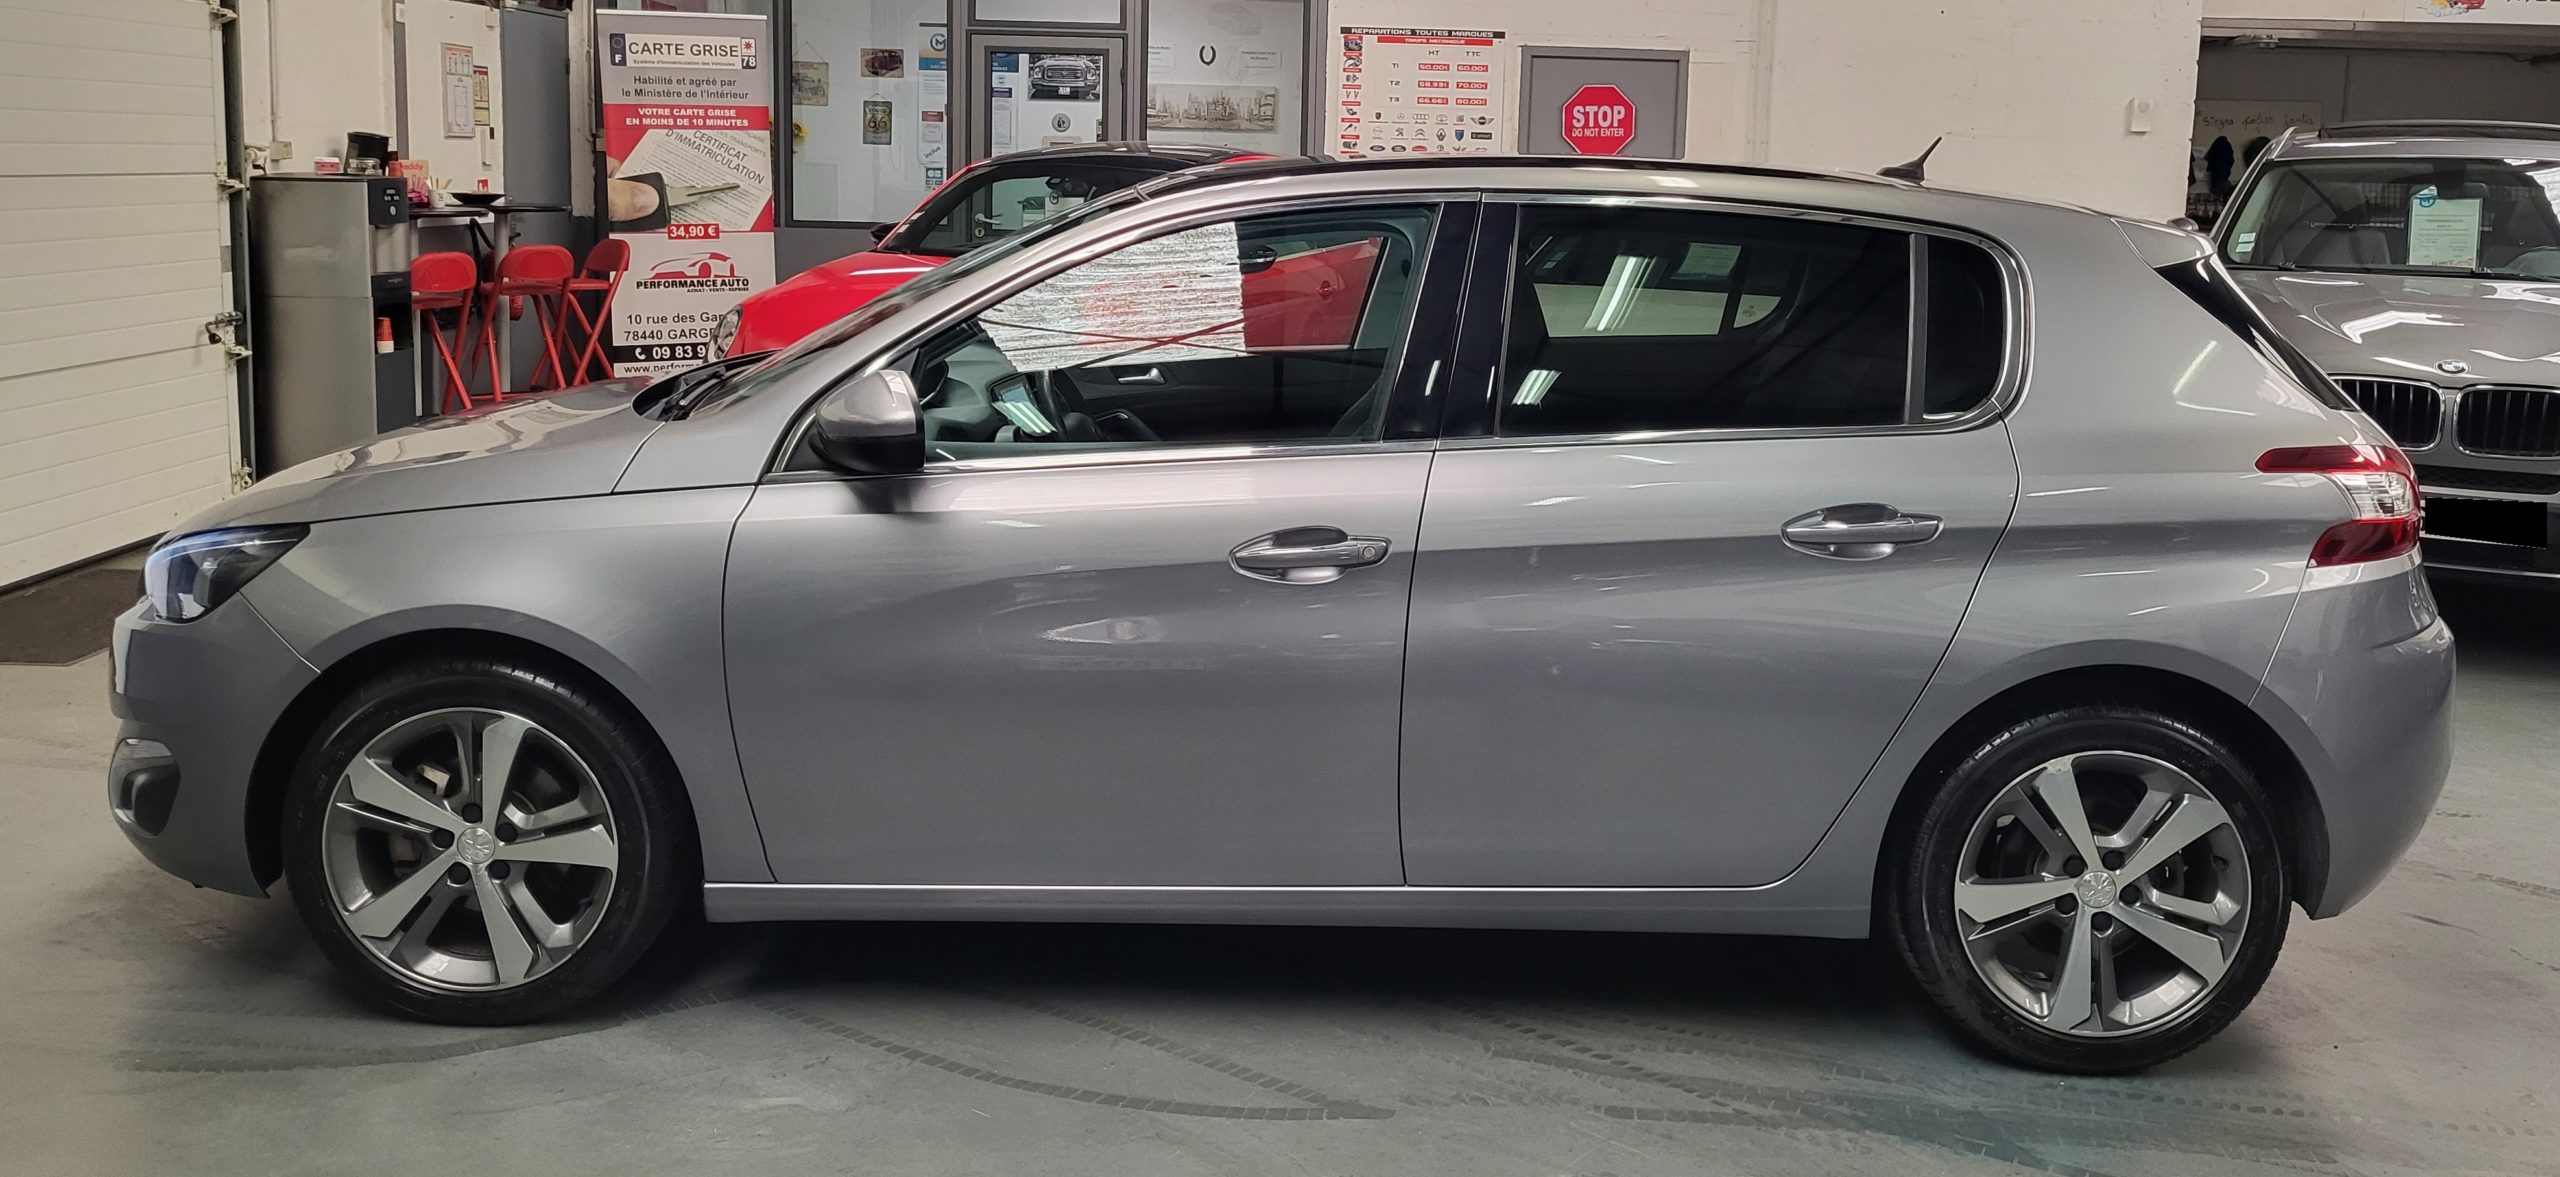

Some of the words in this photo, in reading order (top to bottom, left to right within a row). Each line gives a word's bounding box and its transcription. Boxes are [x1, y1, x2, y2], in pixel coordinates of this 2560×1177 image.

[628, 42, 685, 56] CARTE
[690, 43, 739, 58] GRISE
[614, 55, 622, 64] F
[742, 57, 756, 67] 78
[633, 76, 673, 85] Habilité
[676, 77, 686, 86] et
[689, 78, 717, 88] agréé
[720, 80, 737, 89] par
[622, 88, 631, 97] le
[634, 88, 682, 98] Ministère
[685, 89, 697, 98] de
[700, 90, 749, 99] l'Intérieur
[638, 108, 671, 116] VOTRE
[673, 108, 705, 116] CARTE
[707, 109, 736, 117] GRISE
[1572, 105, 1626, 128] STOP
[626, 118, 639, 126] EN
[642, 118, 674, 126] MOINS
[677, 118, 690, 126] DE
[692, 118, 704, 126] 10
[706, 119, 749, 127] MINUTES
[868, 116, 888, 129] 66
[1572, 129, 1583, 137] DO
[1584, 128, 1599, 137] NOT
[1600, 128, 1625, 137] ENTER
[693, 130, 748, 163] CERTIFICAT
[924, 145, 942, 159] Inclus
[665, 128, 765, 185] D'IMMATRICULATION
[670, 226, 704, 238] 34,90
[708, 226, 717, 237] €
[636, 279, 718, 290] PERFORMANCE
[719, 278, 750, 288] AUTO
[626, 314, 642, 325] 10
[646, 315, 668, 325] rue
[672, 313, 696, 324] des
[700, 311, 724, 323] Gar
[624, 330, 663, 342] 78440
[652, 347, 671, 359] 09
[675, 346, 693, 358] 83
[696, 345, 706, 357] 9
